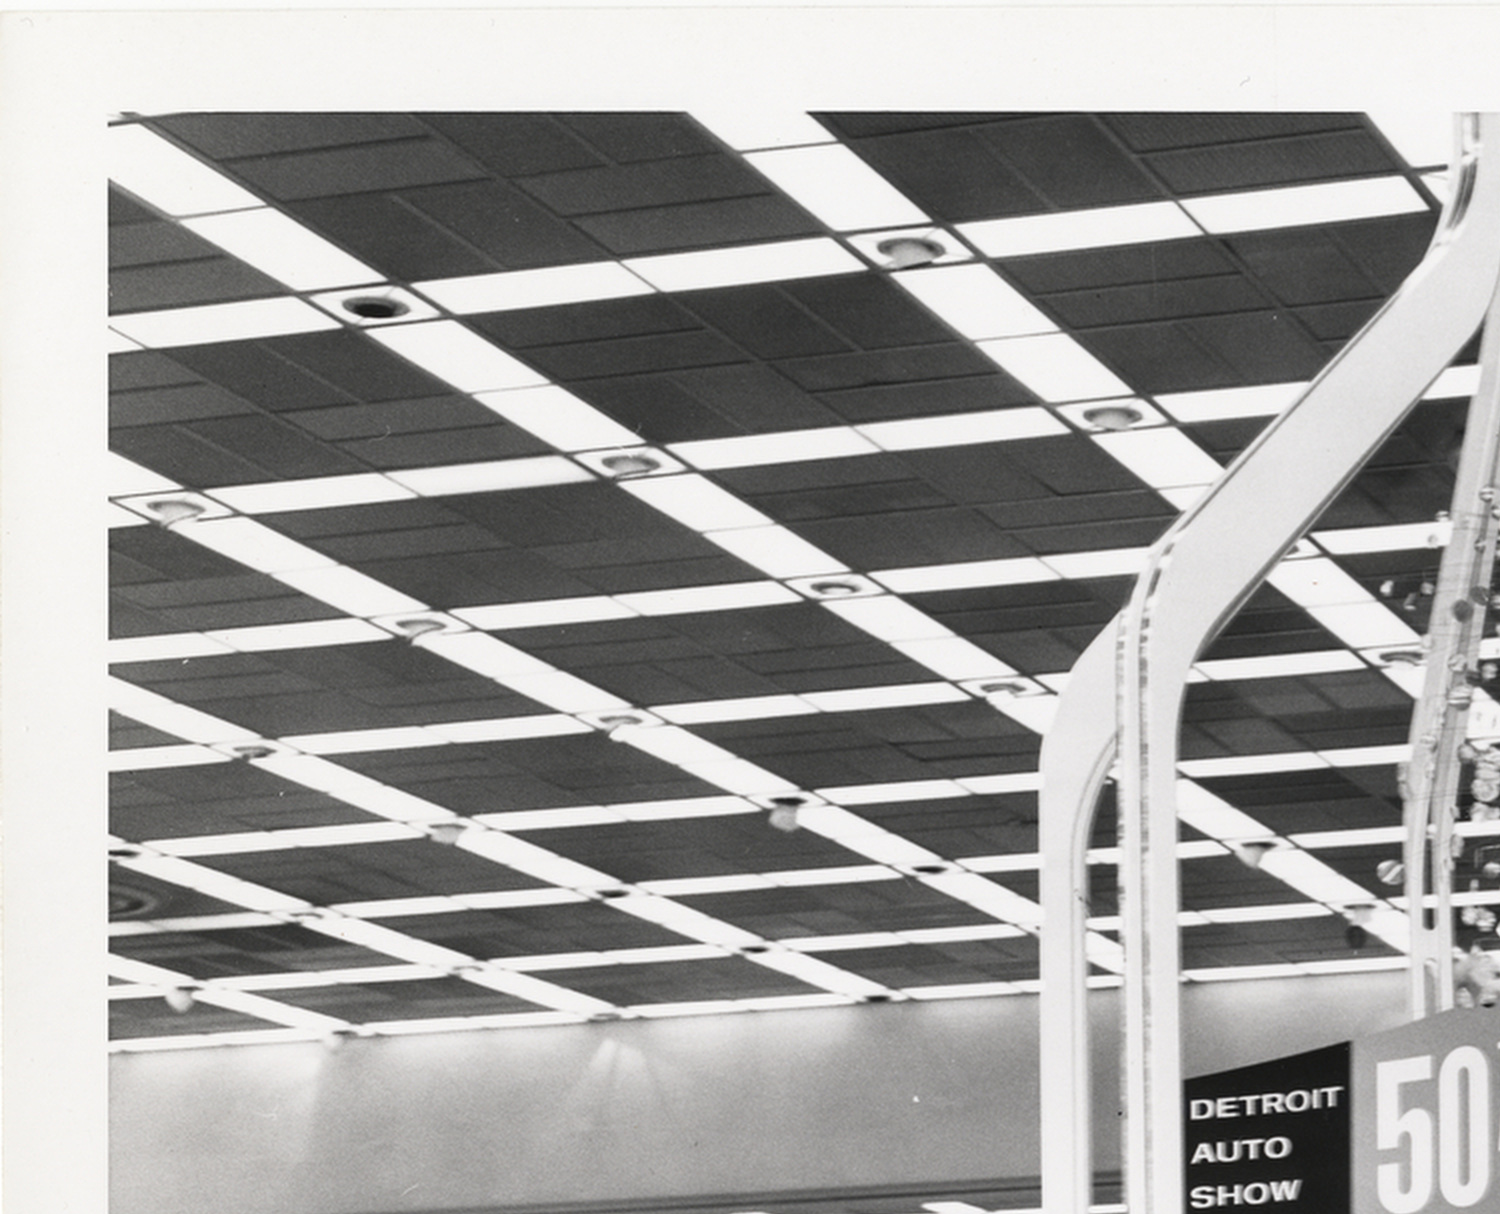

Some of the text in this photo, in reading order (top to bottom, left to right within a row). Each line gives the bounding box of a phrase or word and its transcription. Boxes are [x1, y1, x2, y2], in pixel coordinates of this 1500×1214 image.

[1190, 1086, 1345, 1121] DETROIT
[1190, 1136, 1293, 1165] AUTO
[1190, 1179, 1303, 1209] SHOW
